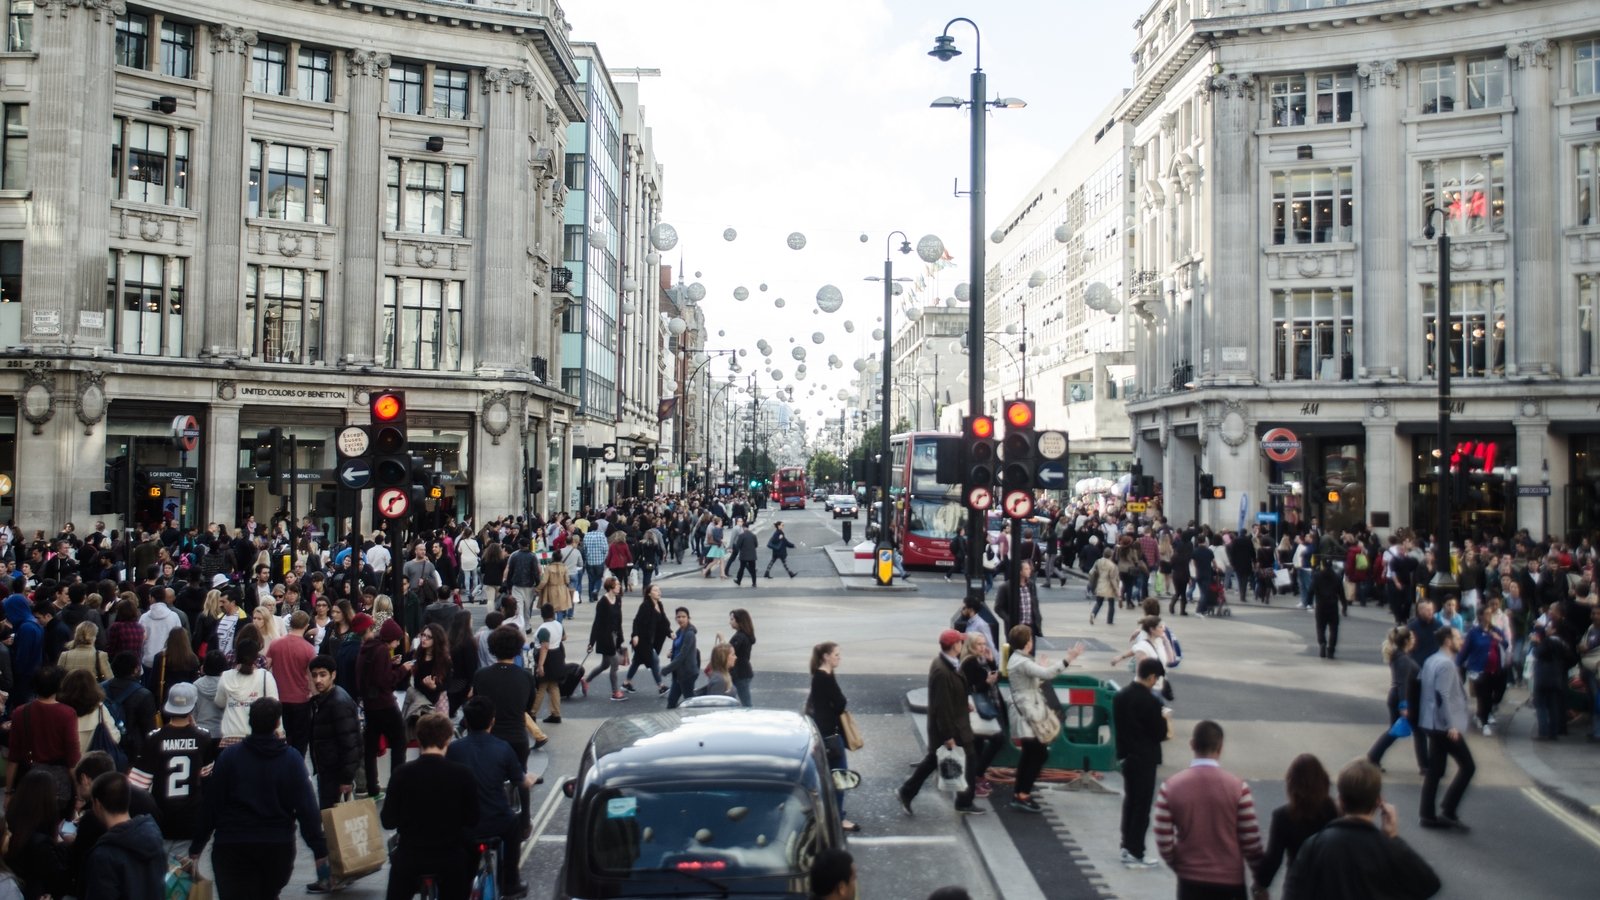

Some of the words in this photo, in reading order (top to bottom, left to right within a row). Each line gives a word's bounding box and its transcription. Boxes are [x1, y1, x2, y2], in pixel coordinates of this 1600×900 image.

[241, 387, 267, 396] UNITED
[267, 389, 296, 397] COLORS
[1300, 403, 1319, 415] H&M
[604, 446, 616, 460] 3
[150, 487, 161, 497] 06
[163, 738, 199, 751] MANZIEL
[168, 755, 191, 797] 2
[344, 815, 369, 834] JUST
[352, 829, 369, 845] DO
